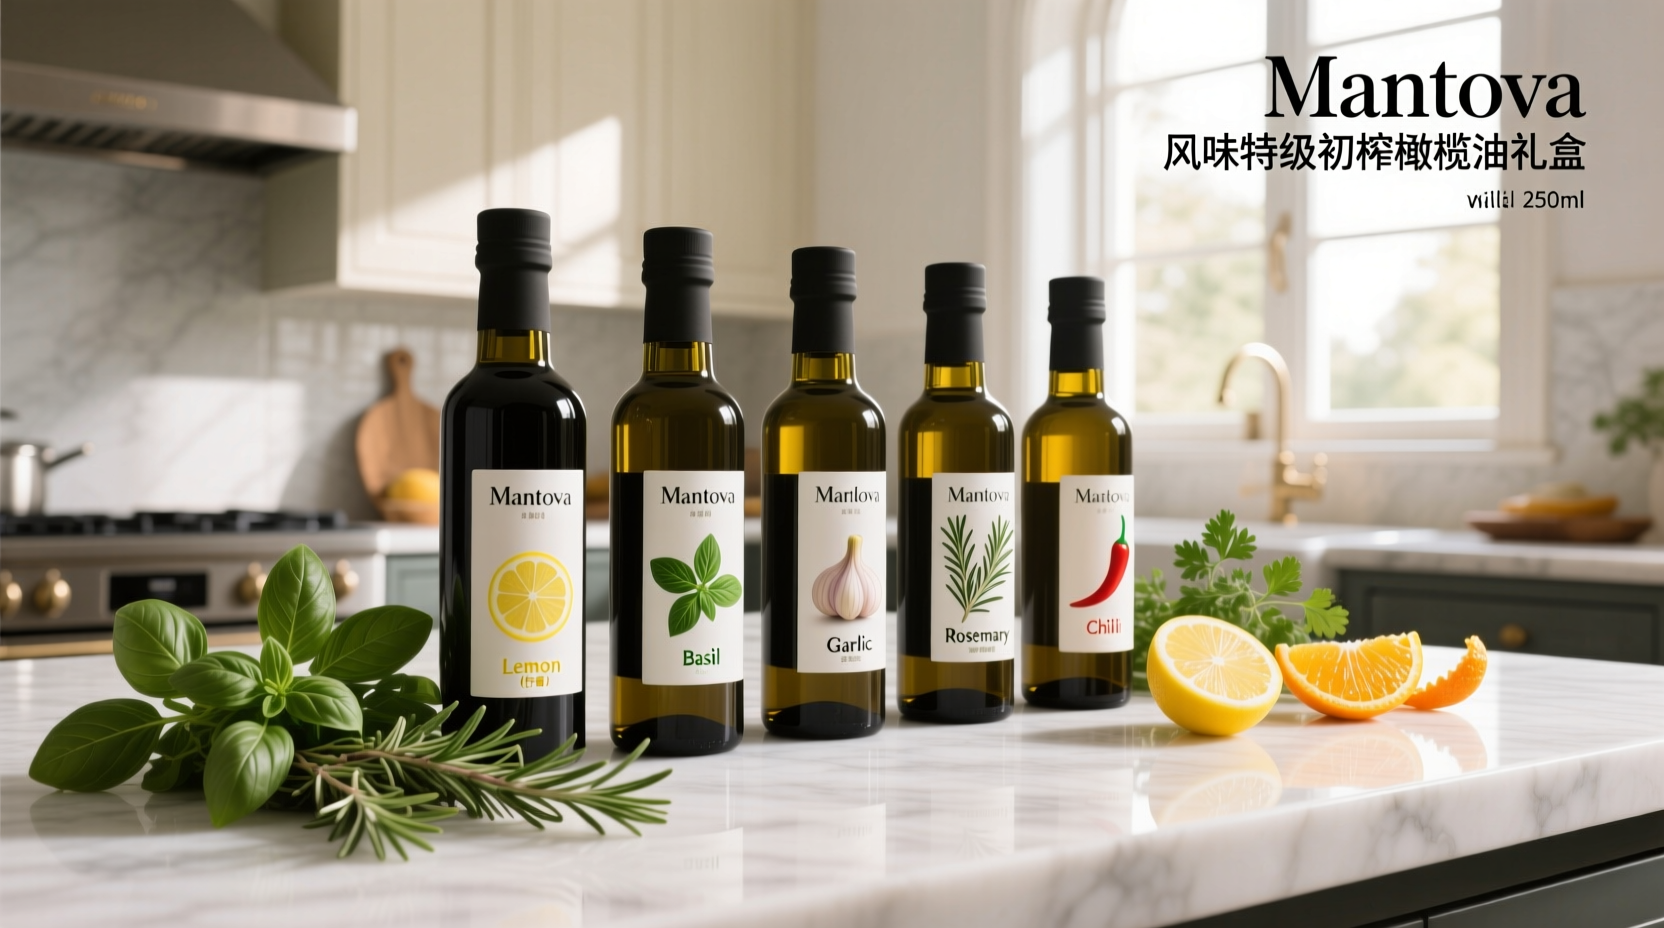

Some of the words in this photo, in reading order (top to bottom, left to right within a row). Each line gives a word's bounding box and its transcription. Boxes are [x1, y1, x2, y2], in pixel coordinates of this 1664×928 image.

[489, 485, 572, 506] Mantova
[661, 486, 735, 504] Mantova
[826, 634, 873, 653] Garlic
[945, 627, 1010, 646] Rosemary
[683, 647, 720, 666] Basil
[502, 658, 561, 675] Lemon
